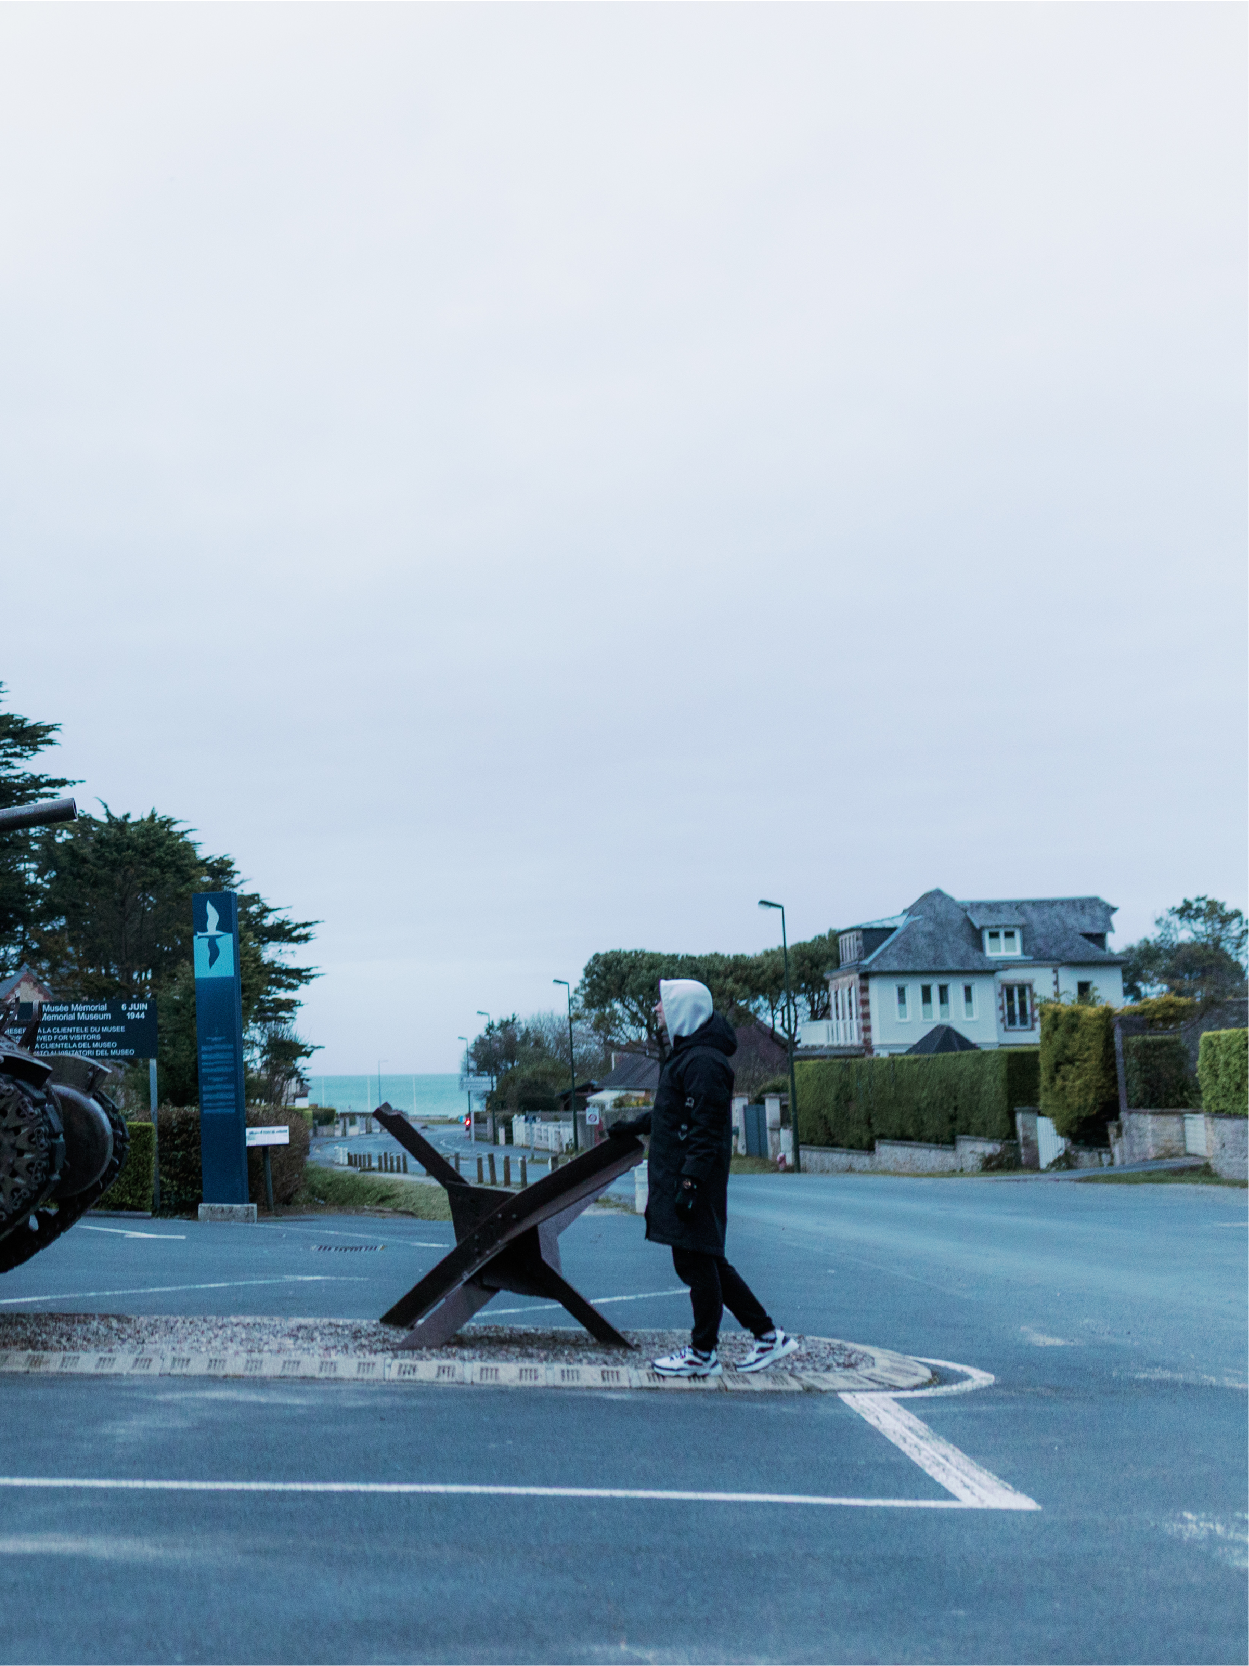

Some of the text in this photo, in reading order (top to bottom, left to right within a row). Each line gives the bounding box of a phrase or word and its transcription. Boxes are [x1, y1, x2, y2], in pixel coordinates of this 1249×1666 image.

[42, 1003, 108, 1013] Musée Mémorial
[121, 1002, 148, 1011] 6 JUIN
[77, 1012, 112, 1021] Museum
[126, 1011, 145, 1020] 1944
[43, 1026, 52, 1034] LA
[52, 1026, 89, 1034] CLIENTELE
[90, 1025, 101, 1033] DU
[101, 1025, 126, 1033] MUSEE
[53, 1034, 68, 1042] FOR
[69, 1033, 102, 1041] VISITORS
[40, 1041, 78, 1050] CLIENTELA
[78, 1041, 91, 1049] DEL
[92, 1041, 118, 1049] MUSEO
[95, 1049, 109, 1057] DEL
[110, 1048, 135, 1057] MUSEO
